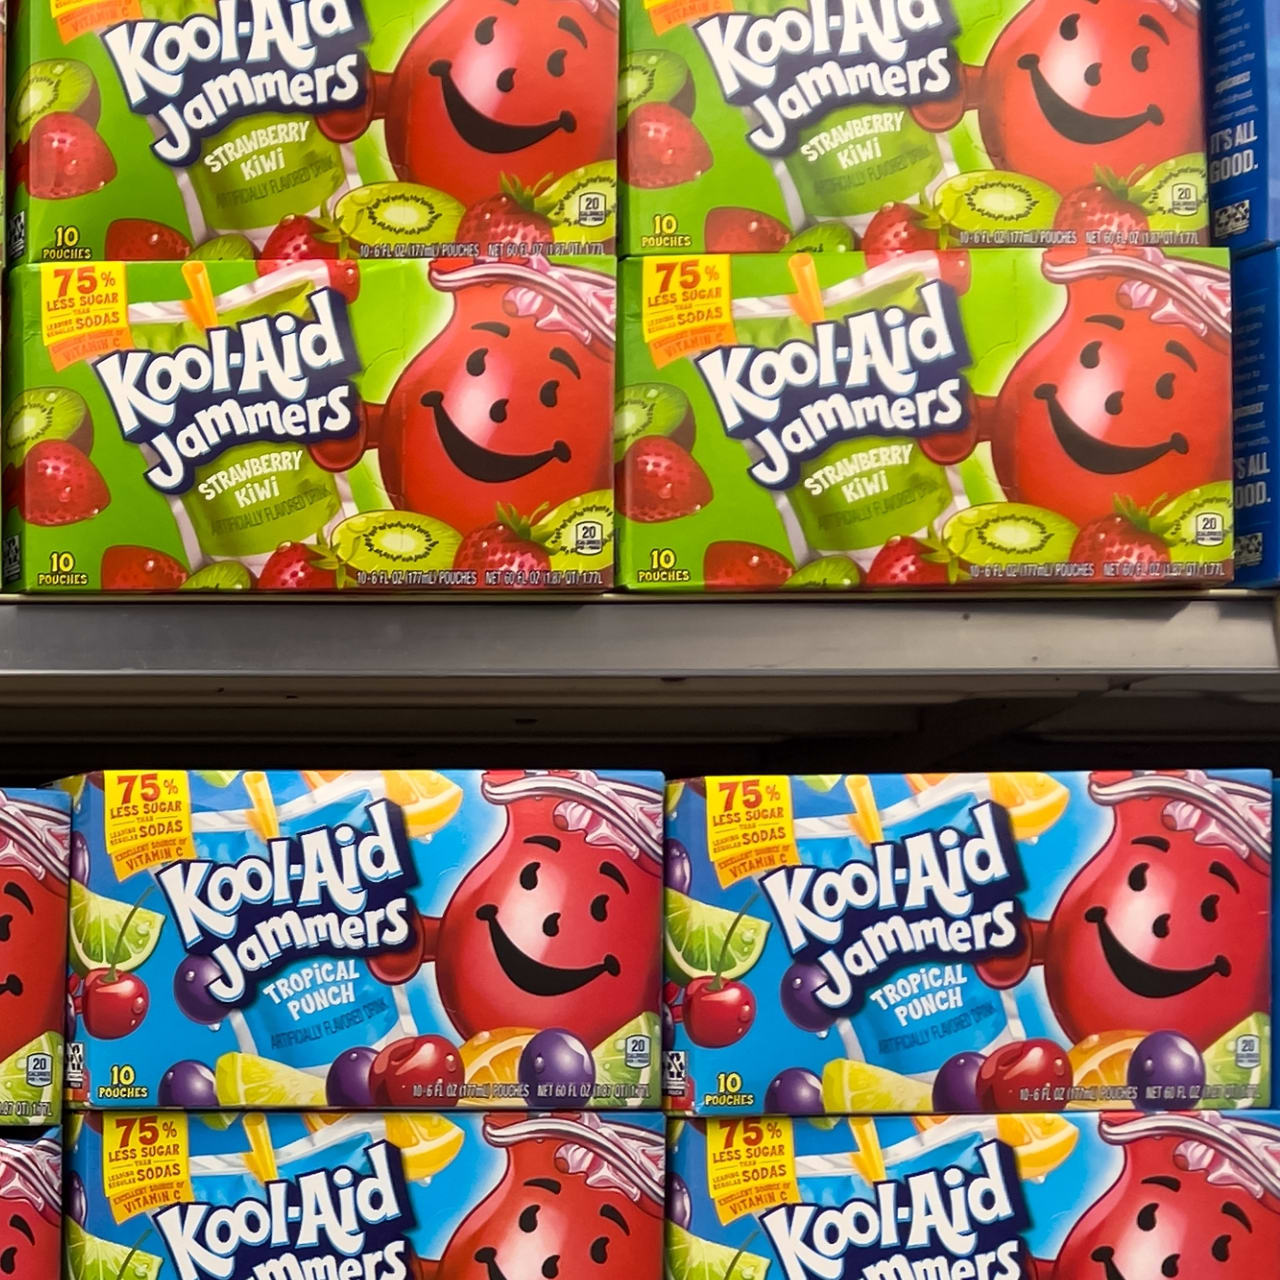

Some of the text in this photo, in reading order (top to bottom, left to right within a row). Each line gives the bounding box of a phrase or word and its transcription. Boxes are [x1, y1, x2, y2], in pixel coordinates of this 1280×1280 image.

[205, 121, 310, 172] STRAWBERRY
[58, 266, 119, 297] 75%
[699, 284, 955, 431] Kool-Aid
[752, 380, 961, 483] Jammers
[804, 444, 912, 495] STRAWBERRY
[763, 803, 1008, 950] Kool-Aid
[815, 902, 1016, 1007] Jammers
[895, 986, 963, 1026] PUNCH
